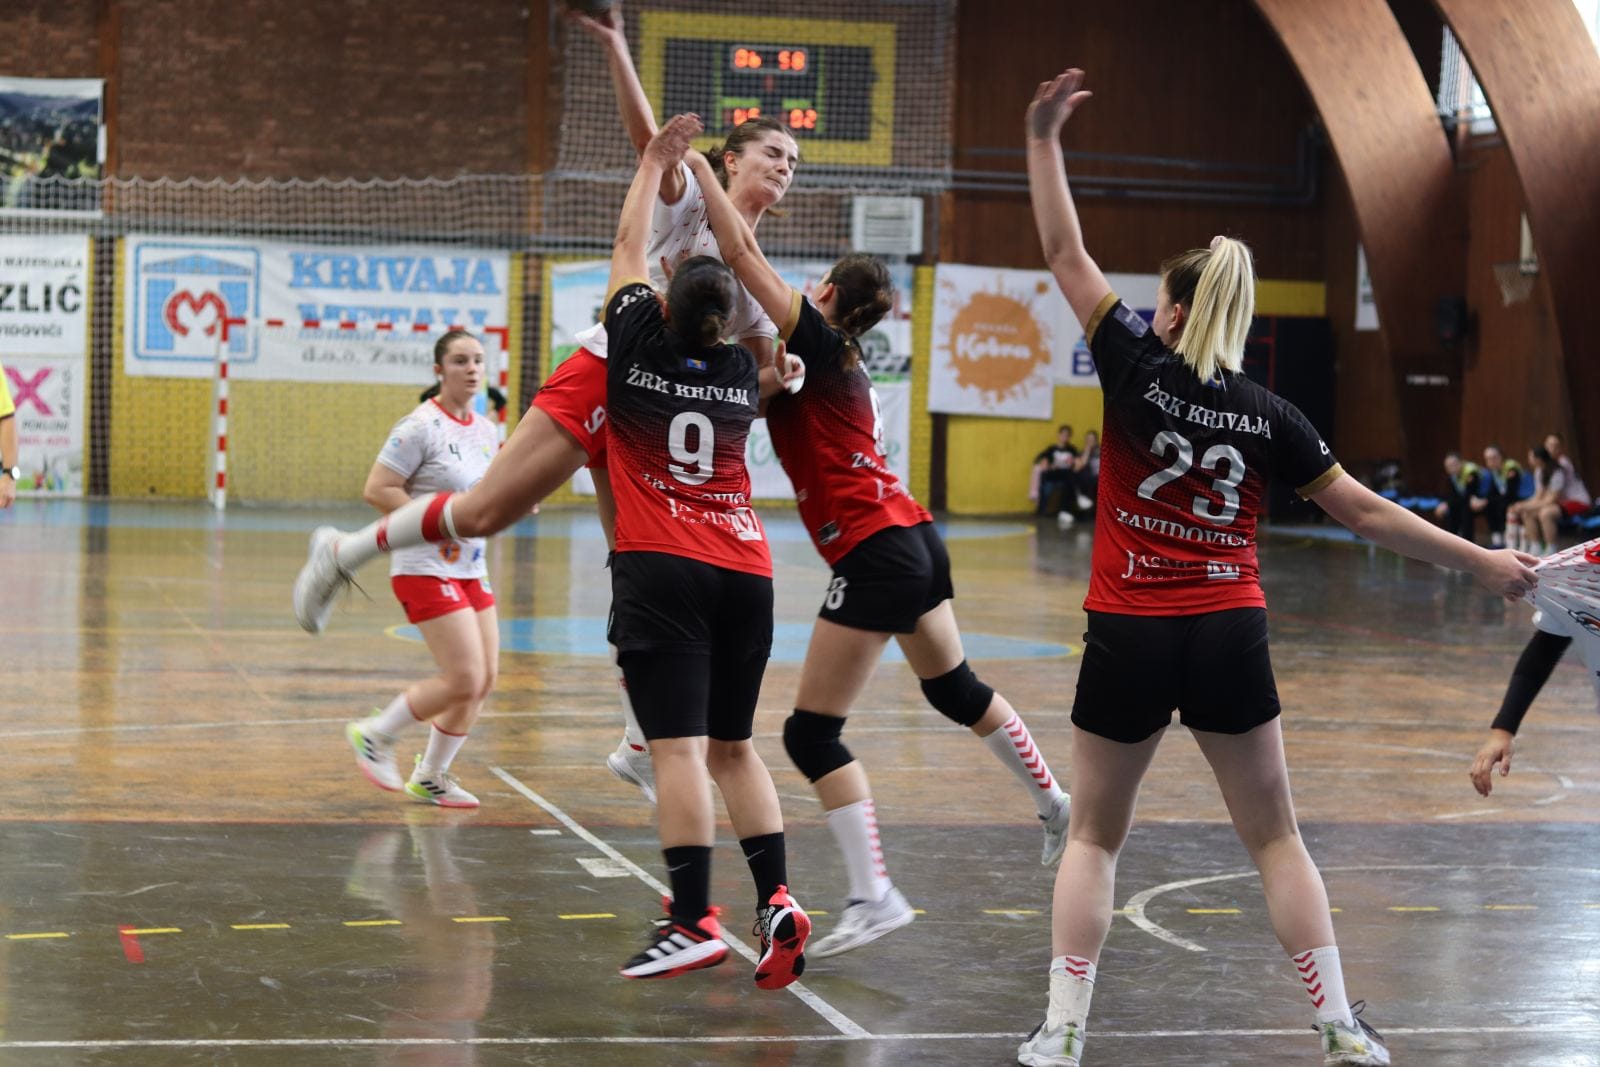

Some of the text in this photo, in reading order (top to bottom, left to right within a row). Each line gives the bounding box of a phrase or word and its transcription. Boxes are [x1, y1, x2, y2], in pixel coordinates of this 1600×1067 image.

[288, 253, 501, 295] KRIVAJA
[0, 322, 62, 336] IDOVIĆI
[626, 363, 750, 406] ŽRK KRIVAJA
[1186, 404, 1272, 440] KRIVAJA
[668, 411, 715, 486] 9
[1137, 430, 1246, 526] 23
